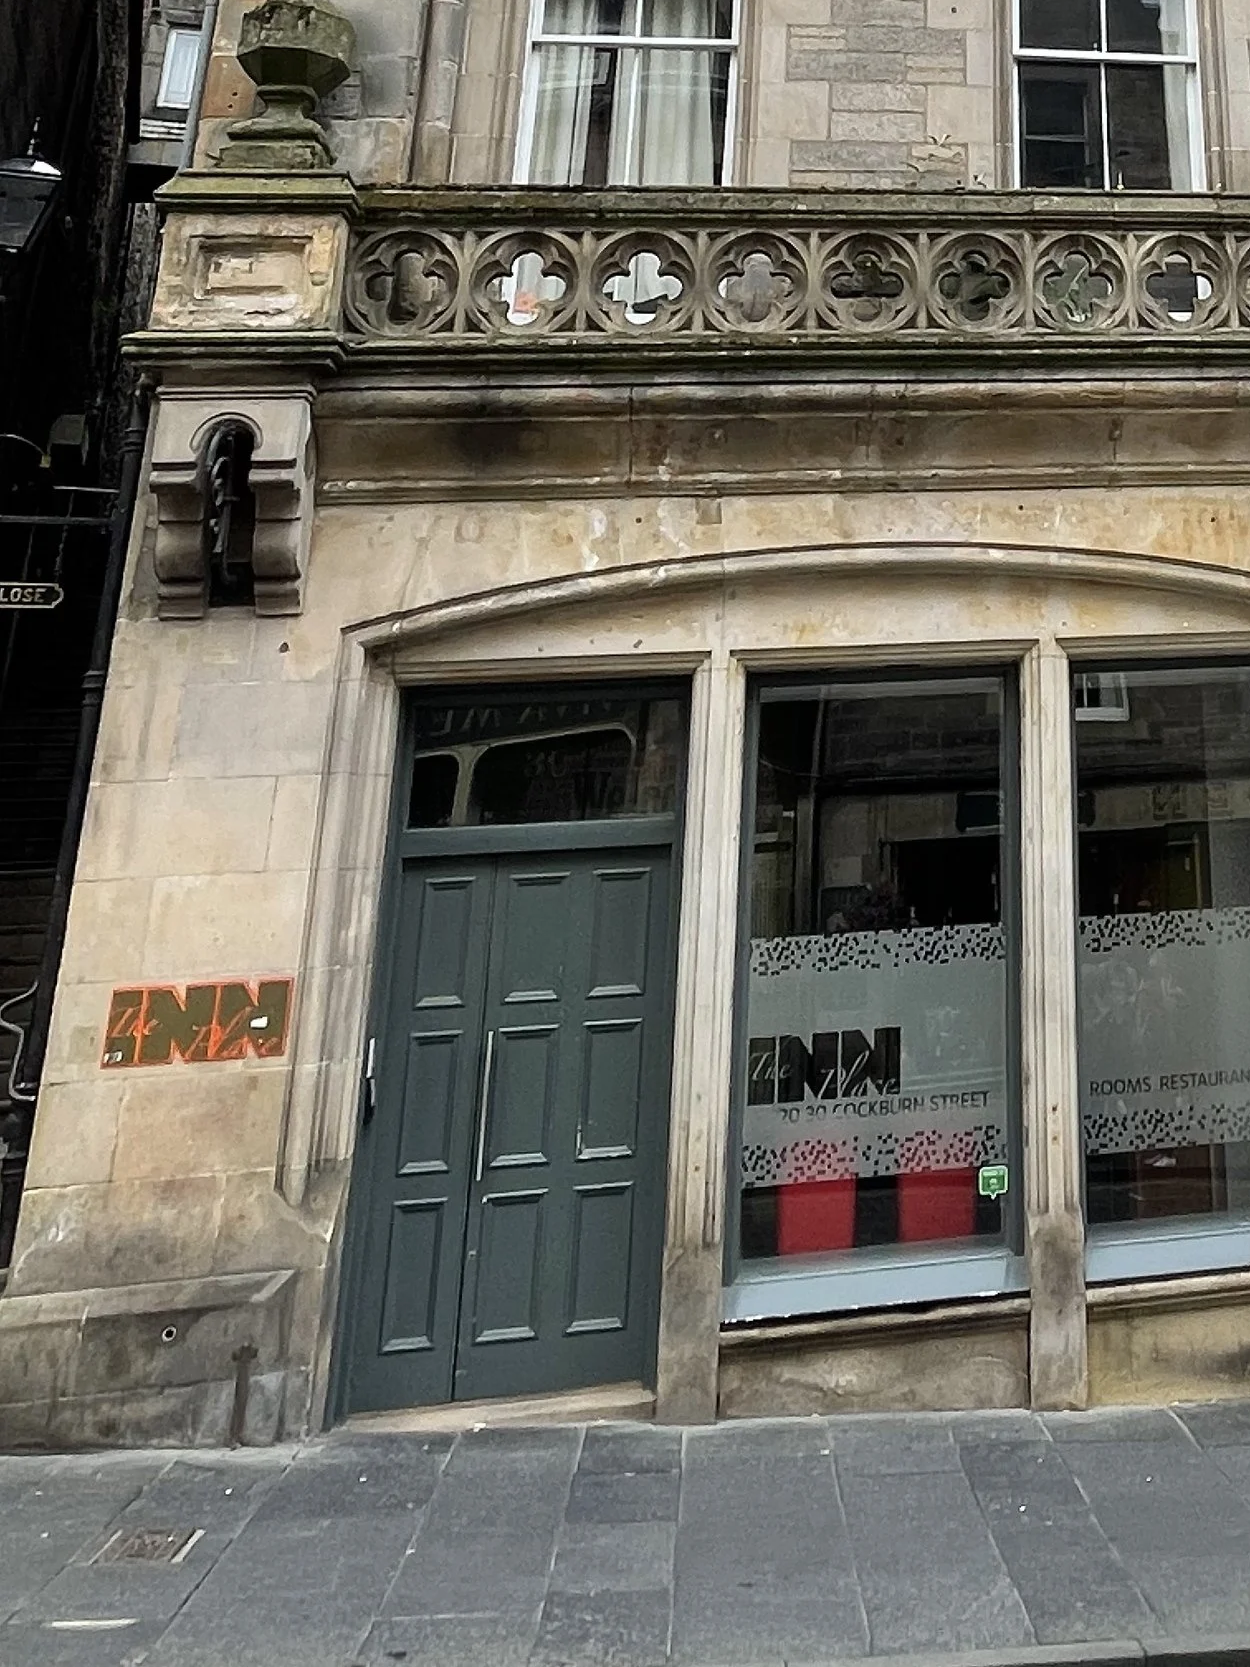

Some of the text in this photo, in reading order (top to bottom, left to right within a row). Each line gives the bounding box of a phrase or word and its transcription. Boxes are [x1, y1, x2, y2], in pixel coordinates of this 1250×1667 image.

[102, 978, 292, 1069] INN
[747, 1026, 901, 1107] INN
[1089, 1076, 1151, 1097] ROOMS
[832, 1095, 925, 1120] COCKBURN
[929, 1090, 990, 1112] STREET
